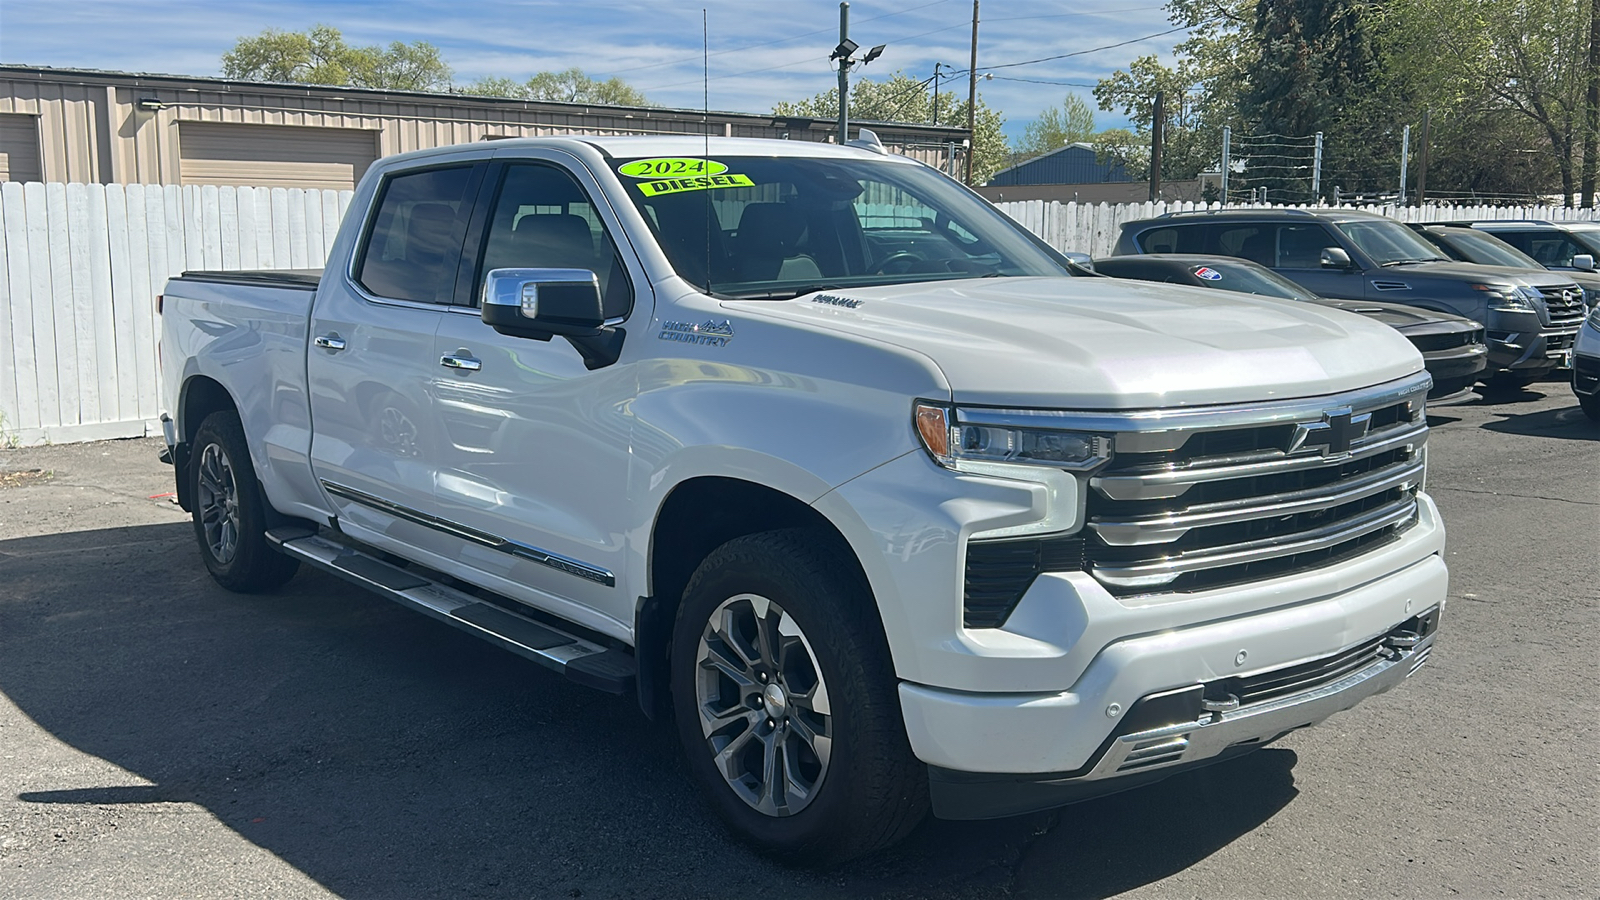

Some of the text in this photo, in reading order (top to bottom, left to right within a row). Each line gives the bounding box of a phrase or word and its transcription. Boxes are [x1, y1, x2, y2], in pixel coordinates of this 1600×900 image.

[637, 161, 705, 176] 2024
[651, 175, 744, 193] DIESEL
[811, 294, 865, 309] DURAMAX
[662, 320, 700, 333] HIGH
[658, 331, 733, 348] COUNTRY
